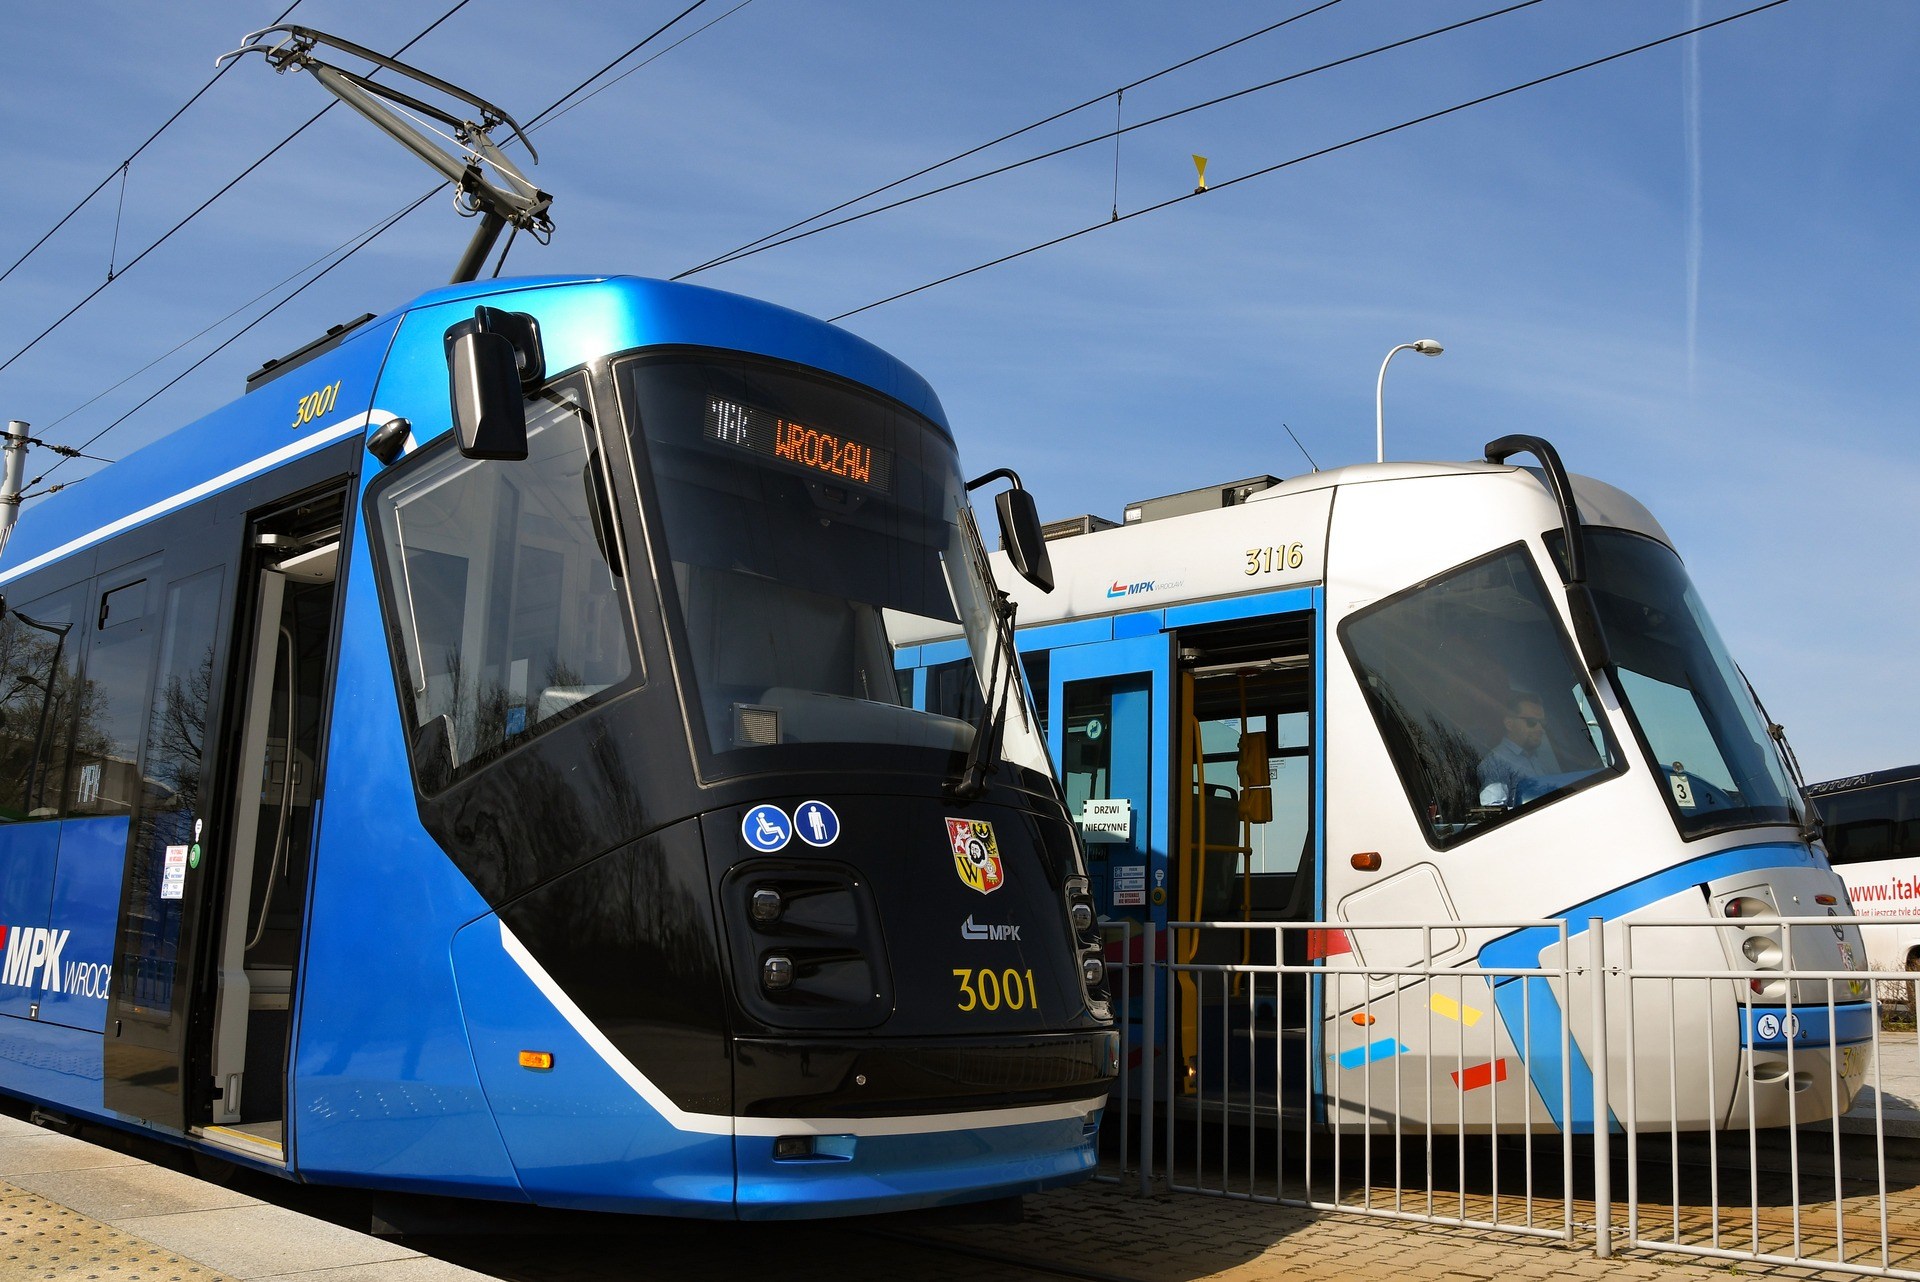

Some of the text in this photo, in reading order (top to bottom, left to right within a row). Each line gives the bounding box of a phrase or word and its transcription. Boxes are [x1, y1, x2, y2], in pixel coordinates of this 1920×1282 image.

[292, 379, 343, 429] 3001
[775, 419, 871, 483] WROCŁAW
[1244, 541, 1304, 576] 3116
[1127, 580, 1156, 595] MPK
[1676, 783, 1687, 799] 3
[1094, 805, 1120, 815] DRZWI
[1084, 822, 1128, 832] NIECZYNNE
[989, 924, 1022, 941] MPK
[1, 926, 71, 992] MPK
[952, 968, 1038, 1011] 3001
